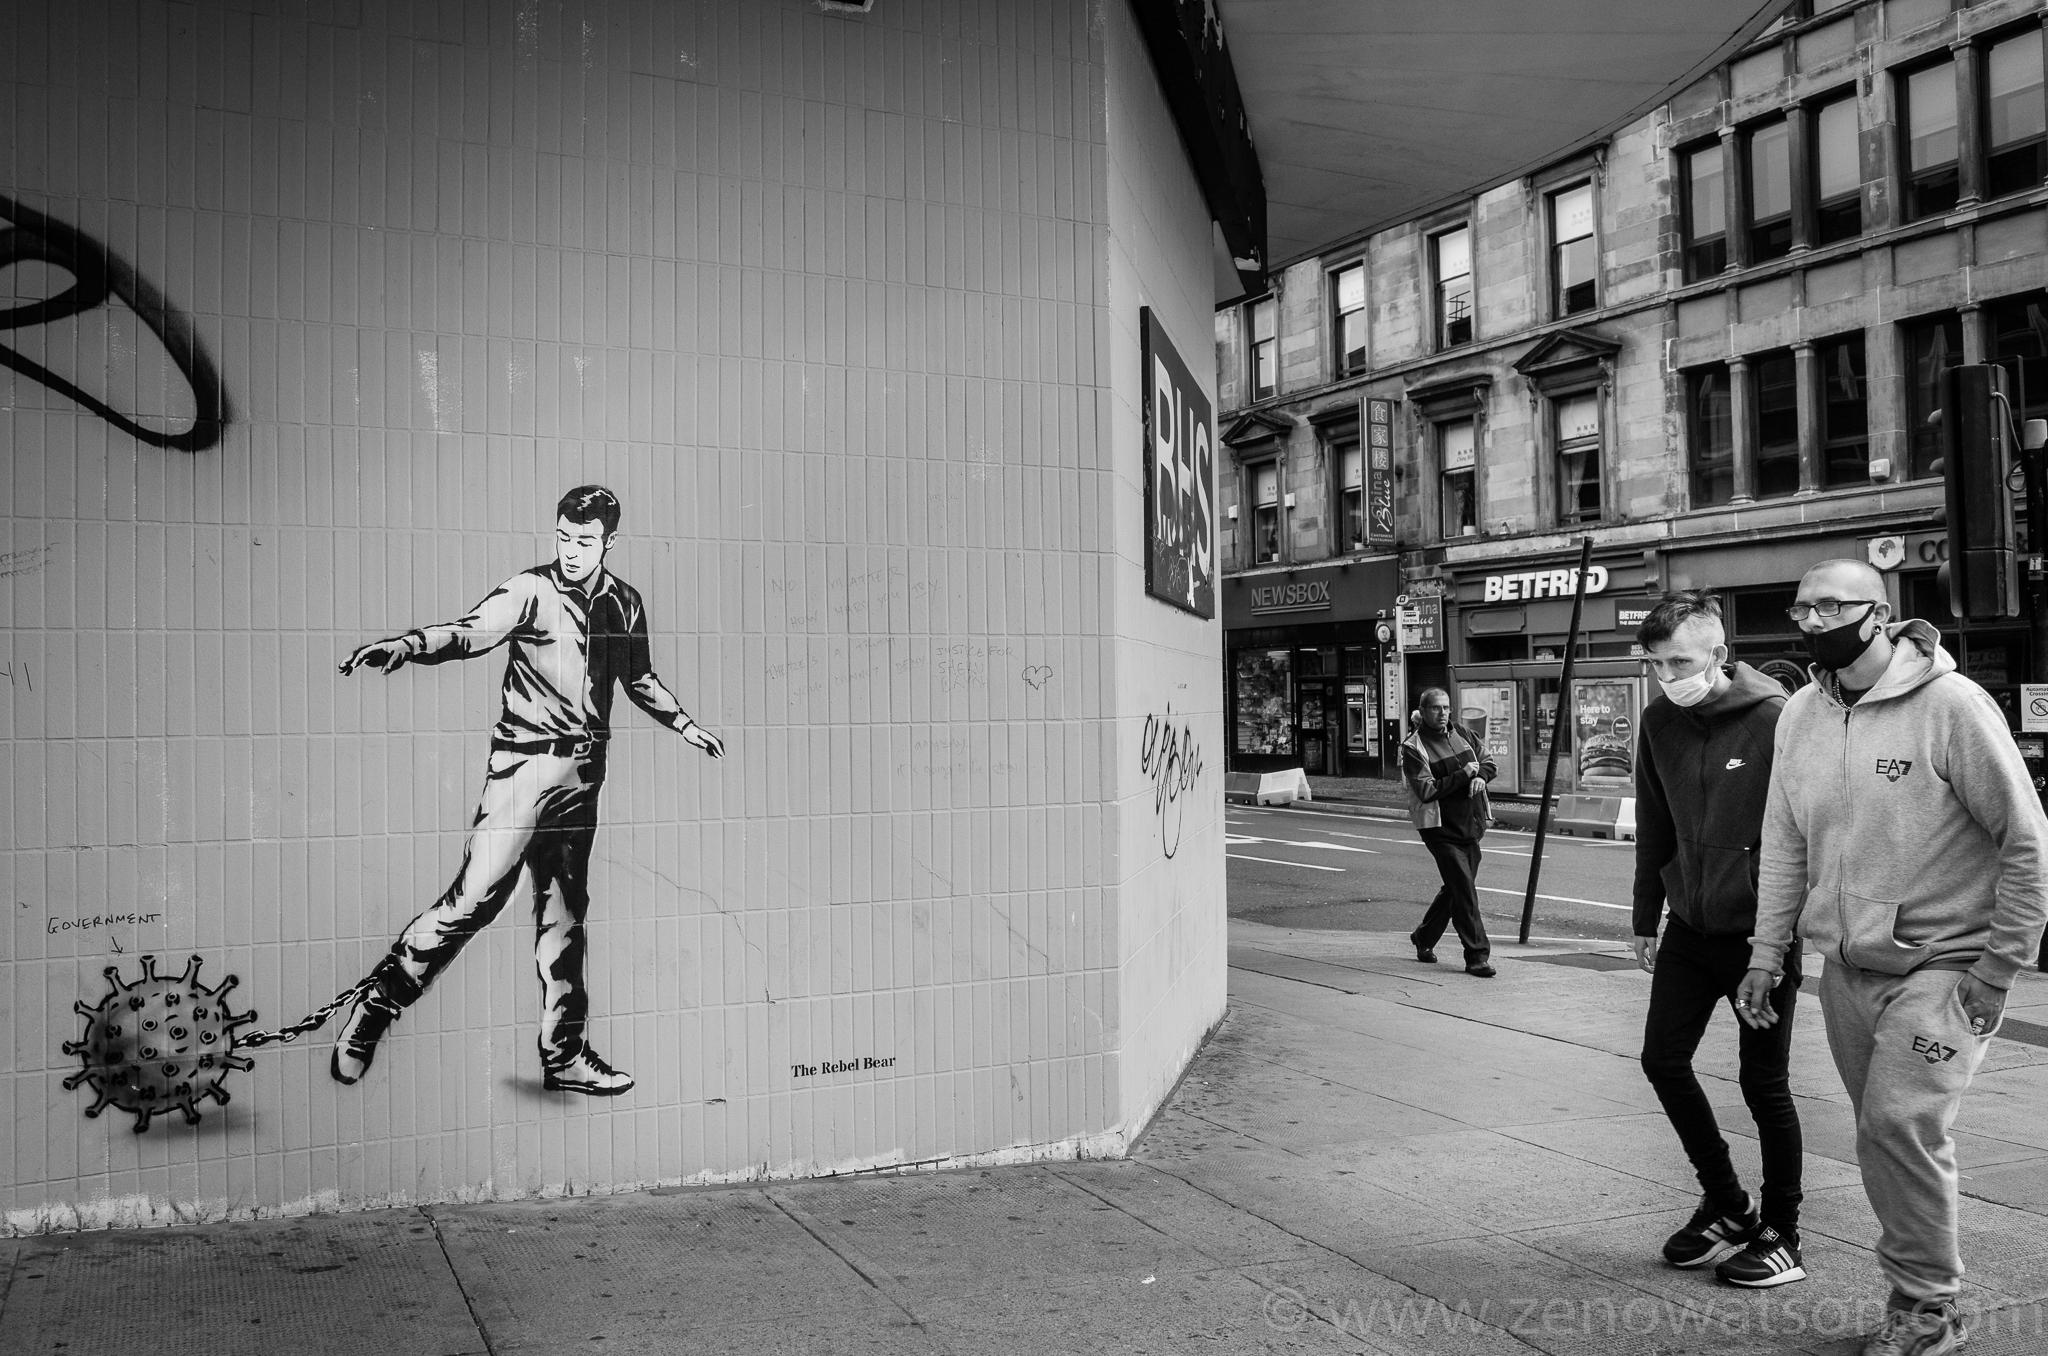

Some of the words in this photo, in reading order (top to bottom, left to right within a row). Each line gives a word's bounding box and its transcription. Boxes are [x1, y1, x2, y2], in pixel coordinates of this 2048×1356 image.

[1377, 478, 1393, 533] Blue
[830, 566, 906, 591] MATTER
[1251, 580, 1330, 607] NEWSBOX
[1618, 610, 1652, 620] BETFRE
[1580, 704, 1600, 714] Here
[1601, 704, 1611, 714] to
[1580, 716, 1599, 727] stay
[1875, 758, 1913, 776] EA7
[47, 912, 162, 934] GOVERNMENT
[1911, 1034, 1959, 1063] EA7
[791, 1063, 817, 1078] The
[821, 1058, 860, 1074] Rebel
[863, 1056, 896, 1070] Bear
